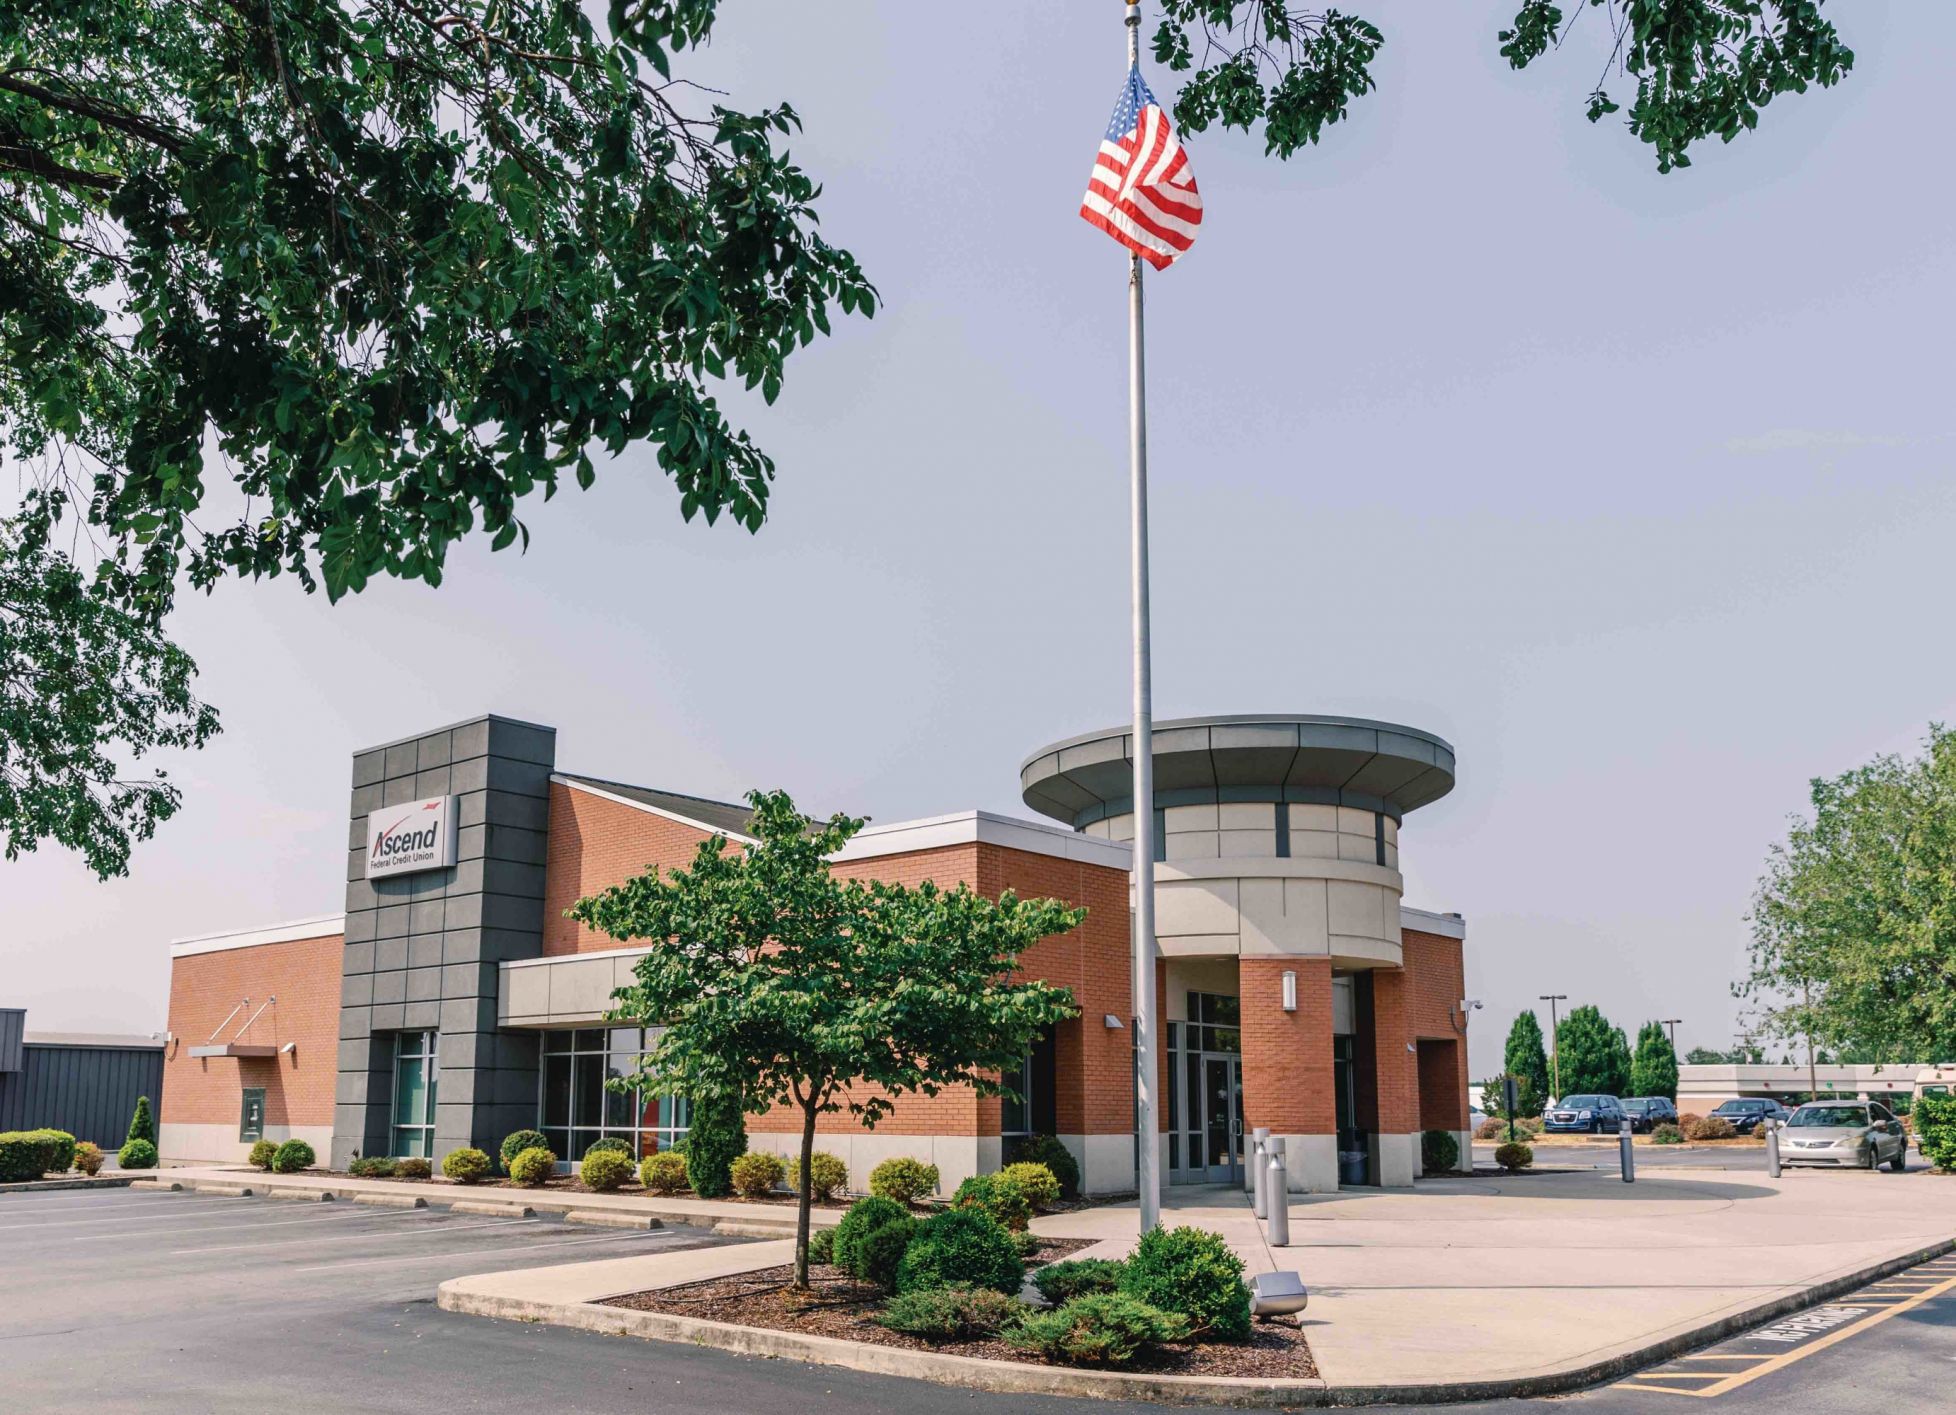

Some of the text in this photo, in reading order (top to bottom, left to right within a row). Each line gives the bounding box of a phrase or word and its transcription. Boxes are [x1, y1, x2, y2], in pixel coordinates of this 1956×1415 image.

[372, 820, 438, 858] Ascend
[370, 851, 434, 870] Federal Credit Union
